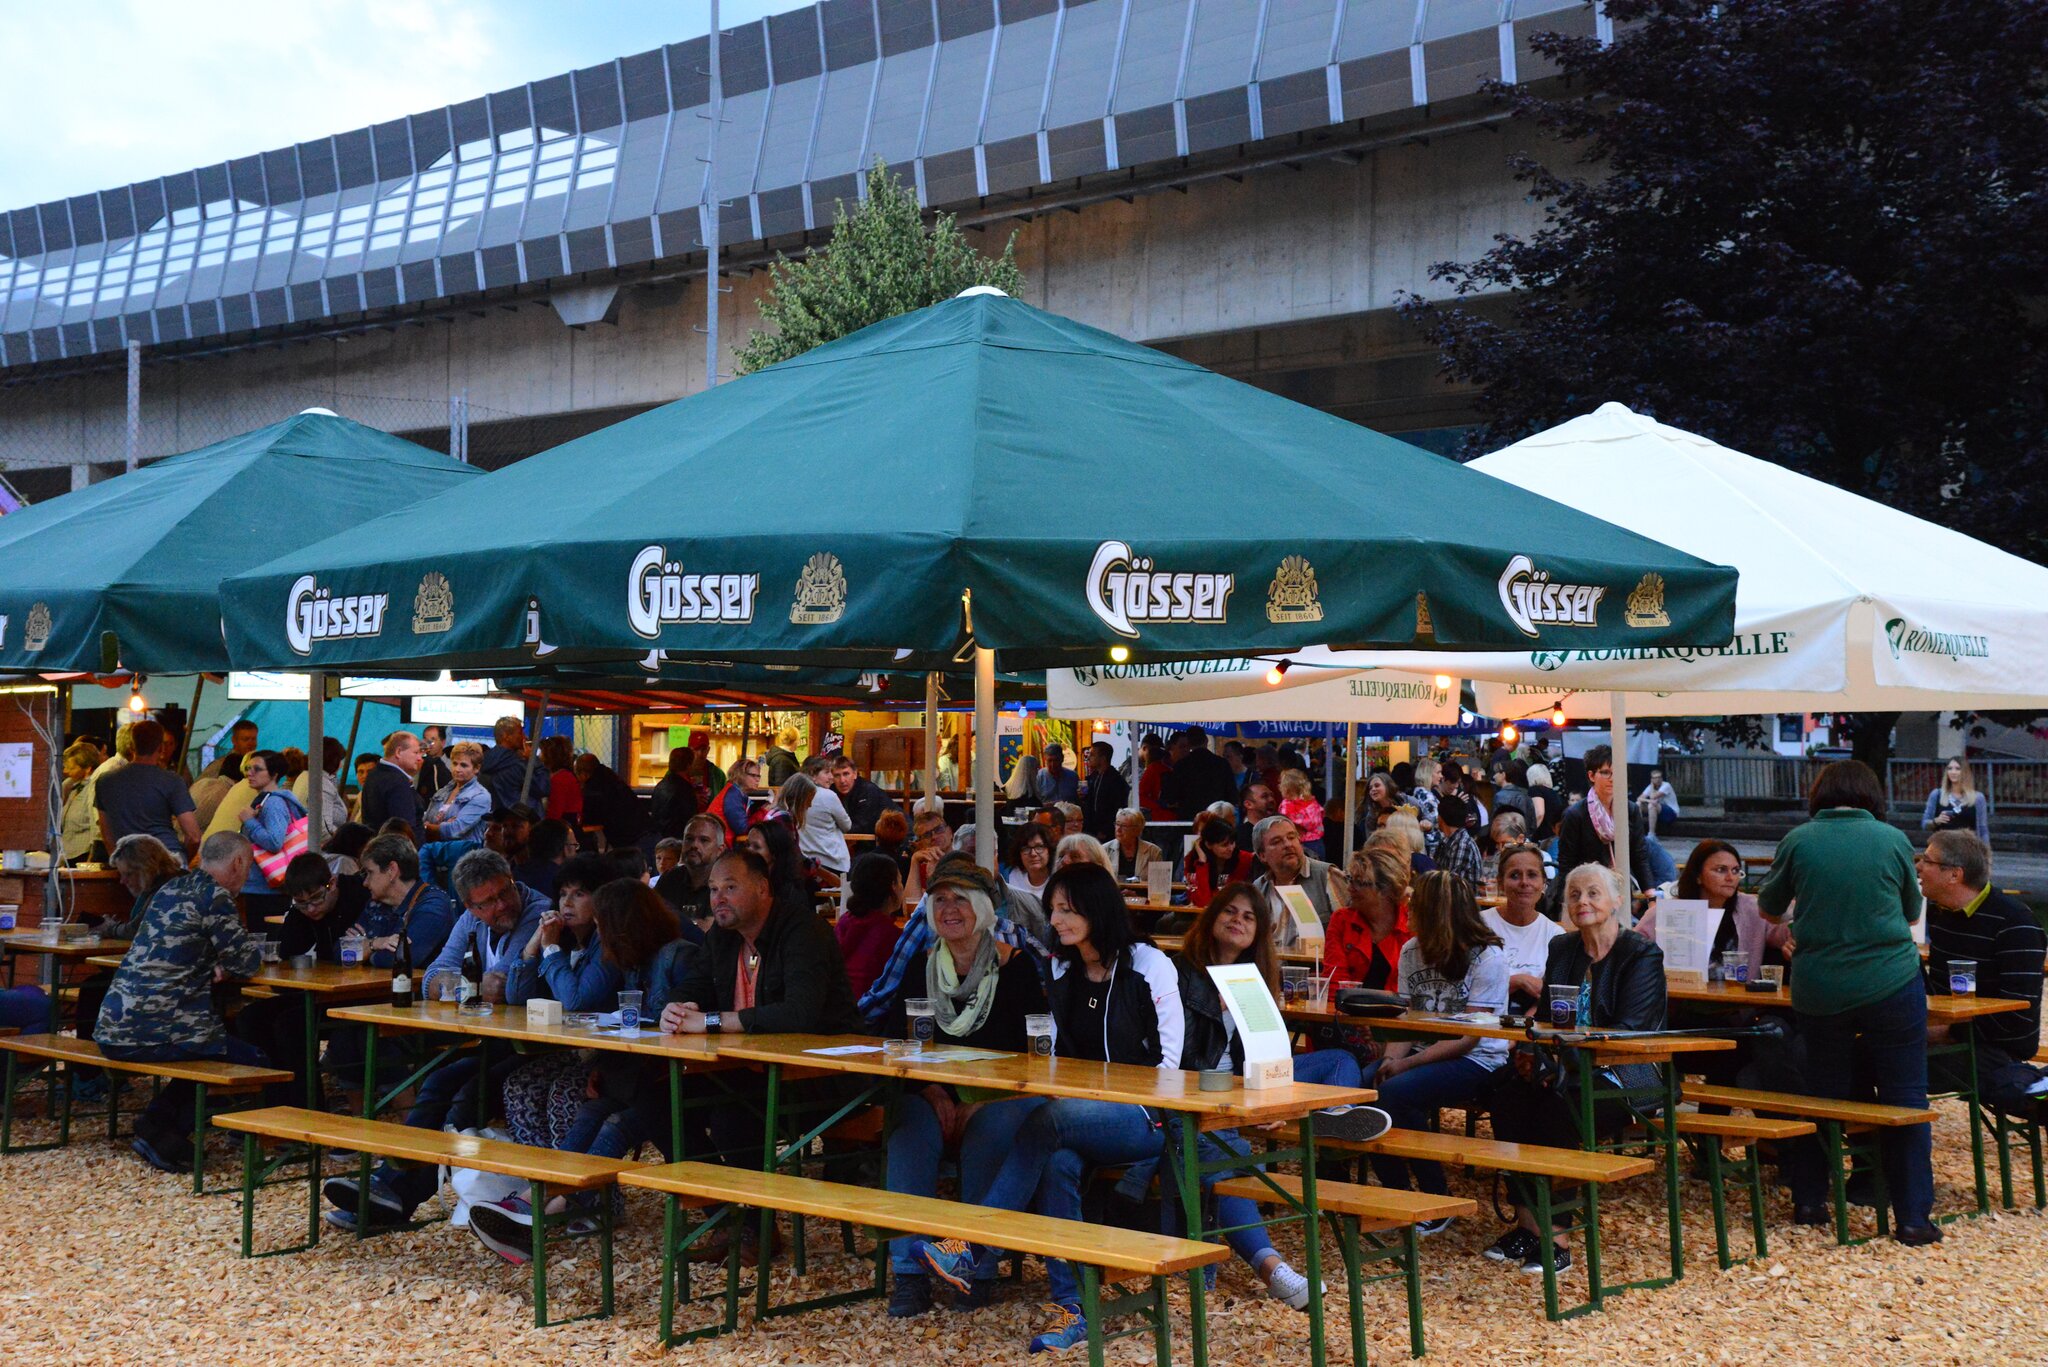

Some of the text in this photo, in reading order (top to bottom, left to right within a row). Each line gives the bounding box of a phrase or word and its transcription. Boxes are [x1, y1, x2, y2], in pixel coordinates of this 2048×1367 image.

[286, 575, 388, 655] Gösser
[627, 545, 759, 639] Gösser
[798, 614, 814, 622] SEIT
[1086, 540, 1235, 638] Gösser
[1275, 613, 1292, 621] SEIT
[1498, 554, 1607, 638] Gösser
[1904, 626, 1989, 662] RÖMERQUELLE
[1004, 724, 1024, 733] Kind
